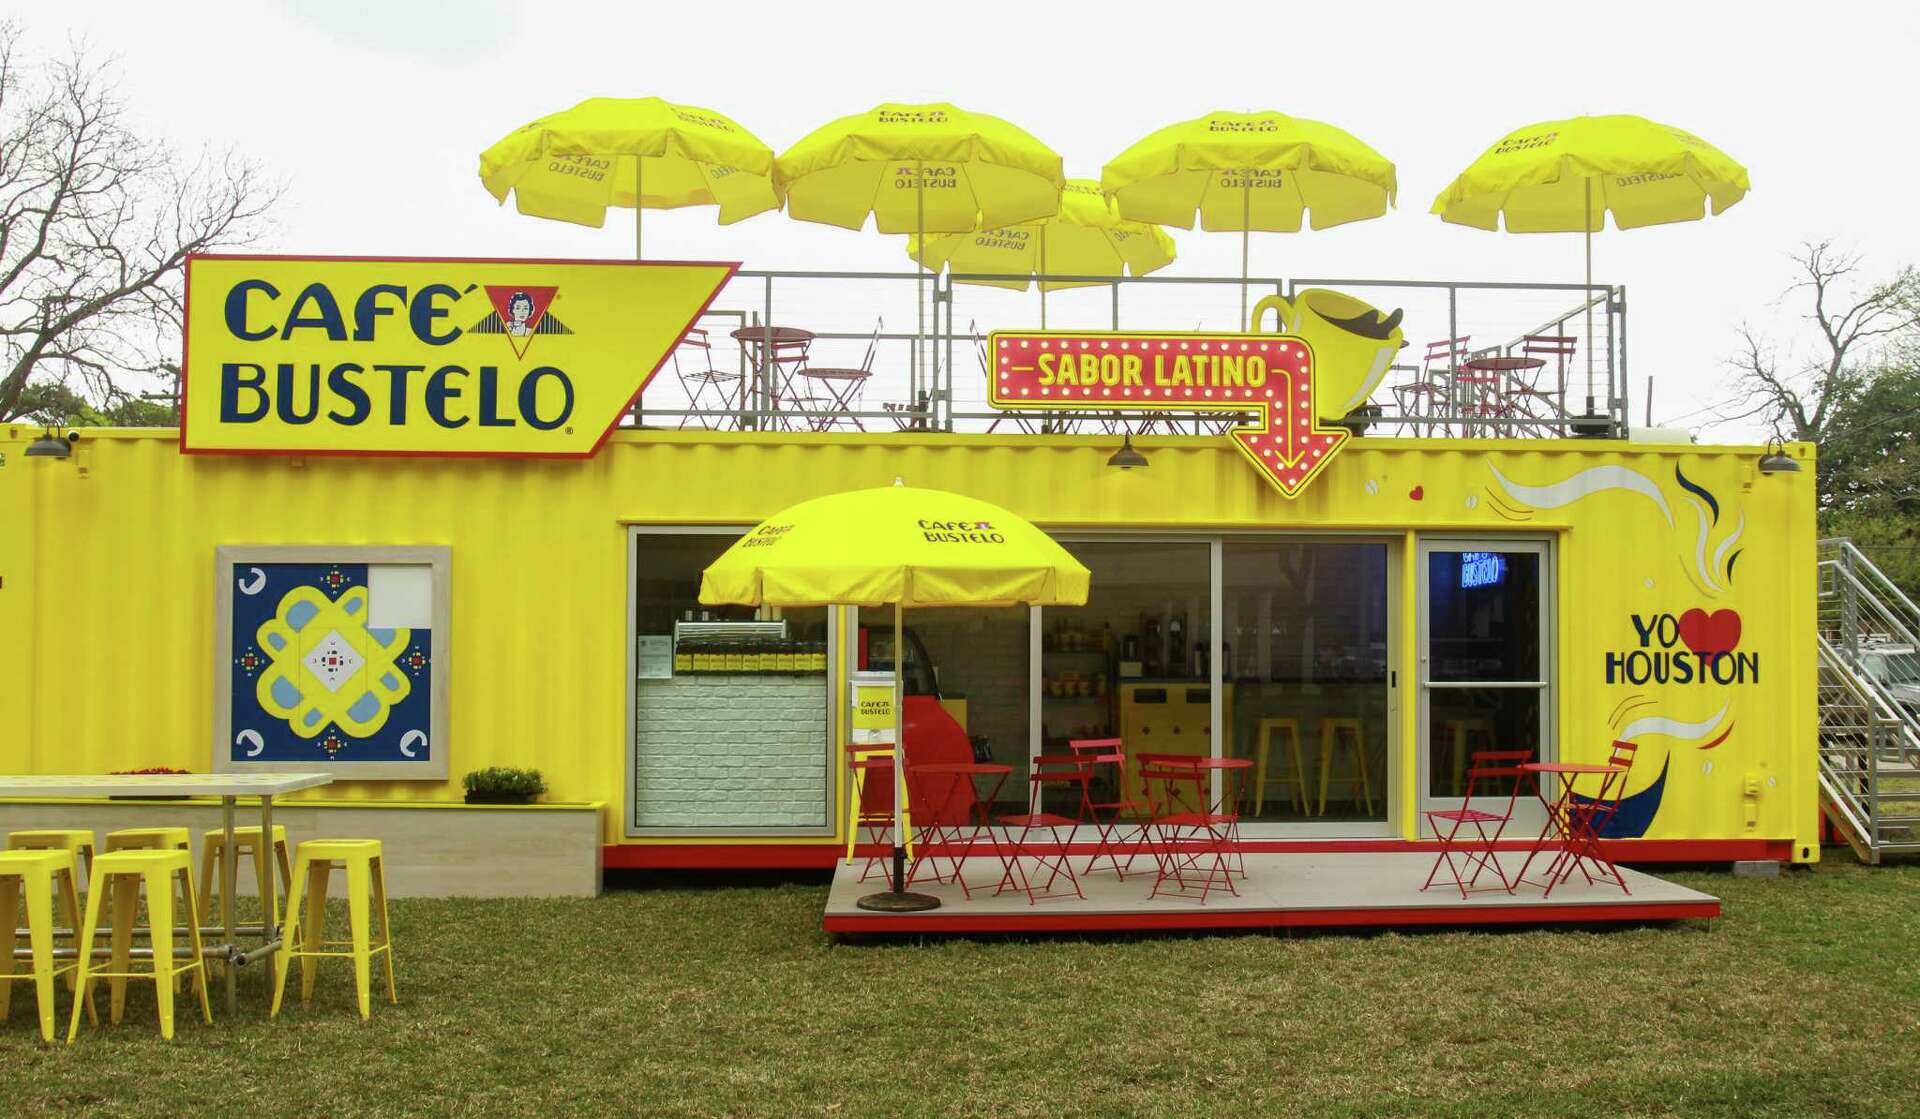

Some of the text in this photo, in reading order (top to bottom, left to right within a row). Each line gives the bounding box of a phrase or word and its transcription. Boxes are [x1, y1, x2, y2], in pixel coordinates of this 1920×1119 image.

[223, 279, 479, 346] CAFÉ
[1038, 353, 1267, 388] SABOR LATINO
[219, 363, 575, 431] BUSTELO
[923, 531, 1005, 544] BUSTELO
[1630, 614, 1680, 649] YO
[1605, 650, 1759, 686] HOUSTON
